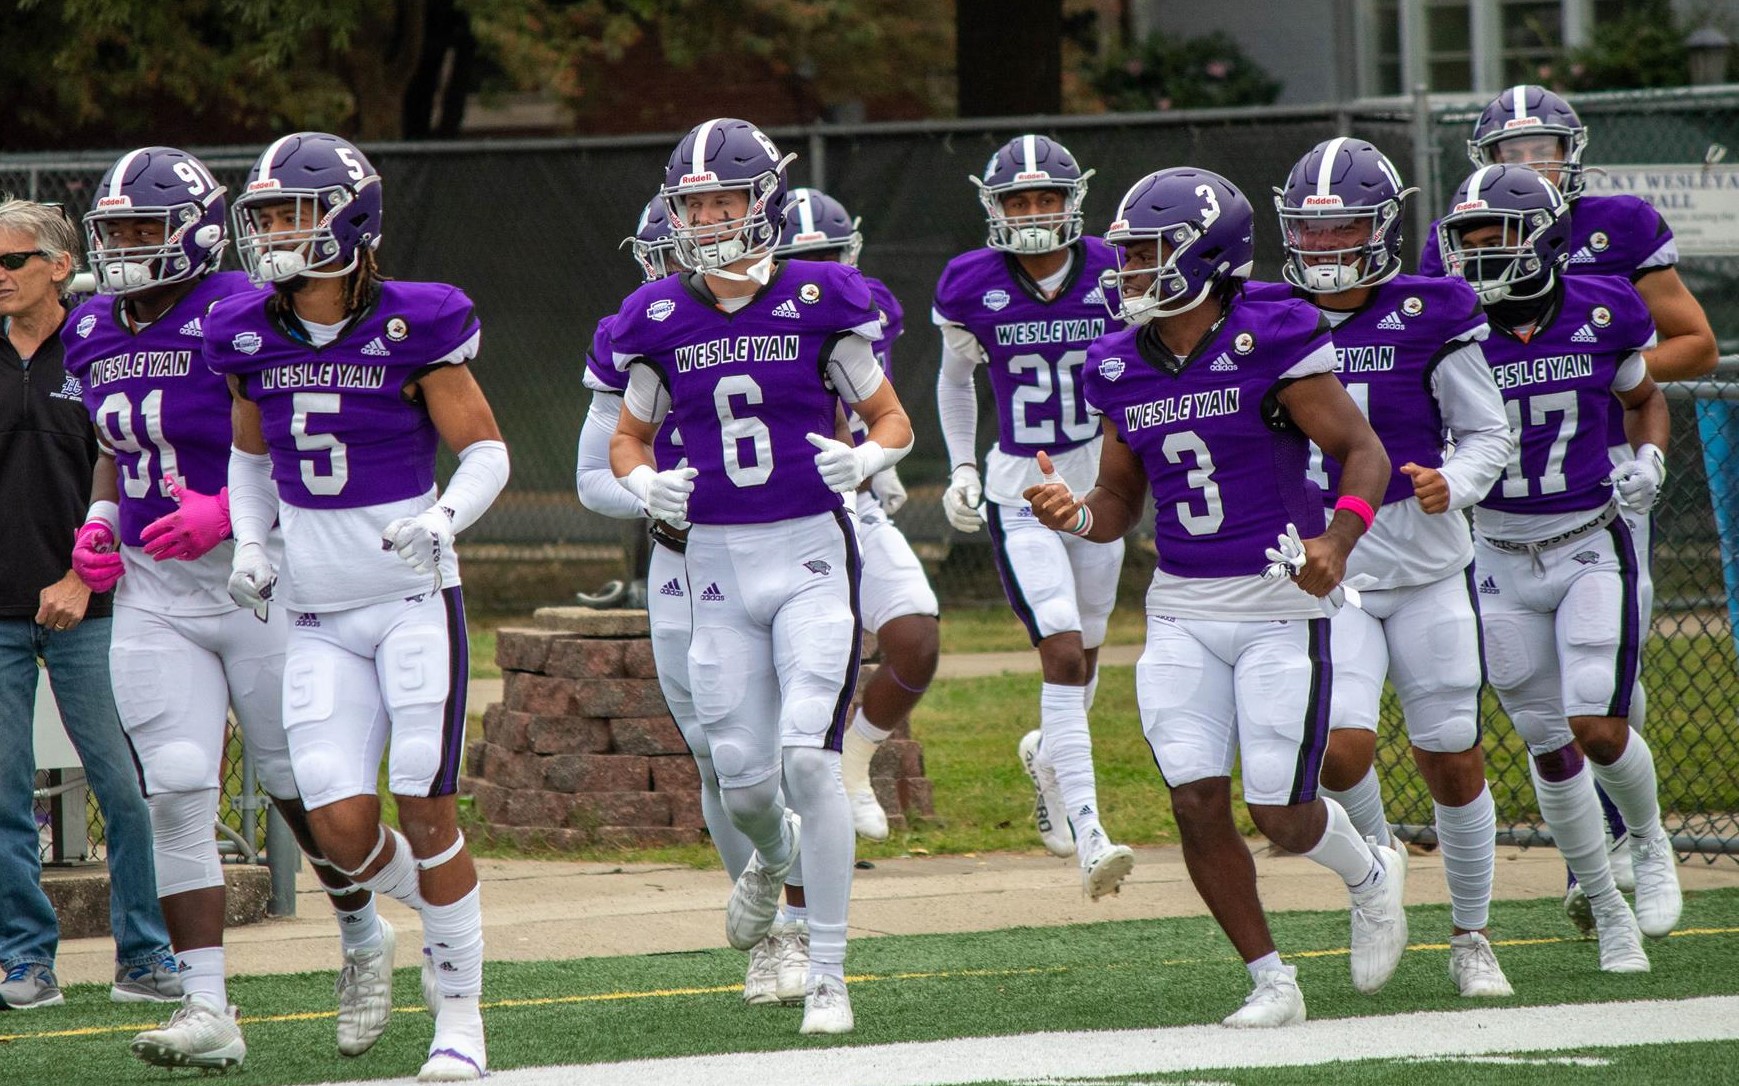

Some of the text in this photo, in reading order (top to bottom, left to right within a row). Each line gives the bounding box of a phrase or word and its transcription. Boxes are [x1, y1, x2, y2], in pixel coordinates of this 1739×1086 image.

[751, 130, 779, 163] 6
[172, 159, 215, 196] 91
[335, 147, 365, 180] 5
[682, 173, 713, 184] Riddell
[1194, 184, 1221, 229] 3
[1306, 197, 1338, 205] Riddell
[771, 309, 800, 319] adidas
[1376, 322, 1406, 331] adidas
[995, 318, 1105, 346] WESLEYAN
[1570, 335, 1598, 343] adidas
[360, 346, 391, 357] adidas
[674, 335, 800, 374] WESLEYAN
[1209, 363, 1239, 372] adidas
[1332, 345, 1396, 373] EYAN
[89, 351, 192, 389] WESLEYAN
[261, 362, 387, 390] WESLEYAN
[1491, 354, 1594, 390] ESLEYAN
[1007, 350, 1101, 444] 20
[1125, 387, 1241, 433] WESLEYAN
[96, 389, 188, 502] 91
[290, 393, 348, 496] 5
[713, 374, 774, 488] 6
[1502, 390, 1579, 499] 17
[1161, 430, 1225, 536] 3
[659, 587, 684, 597] adidas
[700, 593, 725, 602] adidas
[294, 618, 321, 628] adidas
